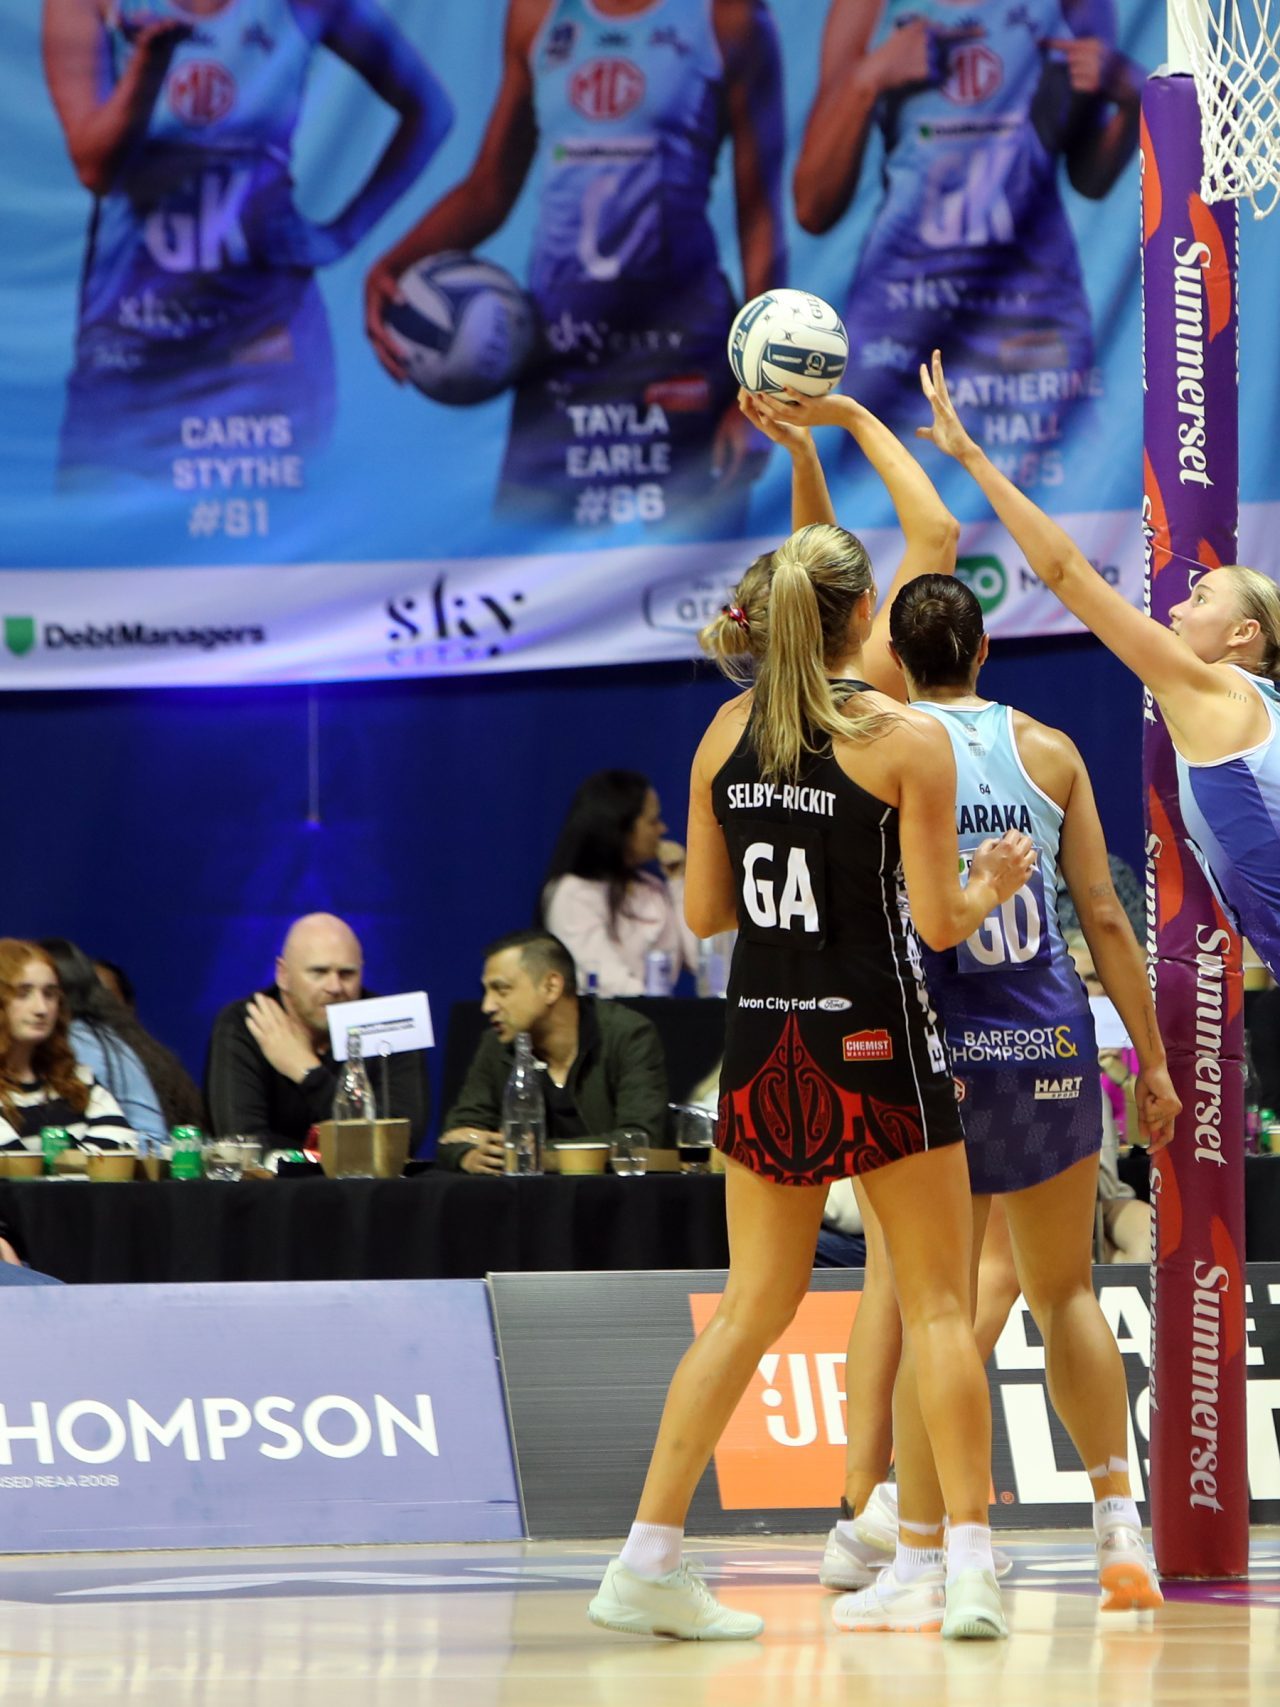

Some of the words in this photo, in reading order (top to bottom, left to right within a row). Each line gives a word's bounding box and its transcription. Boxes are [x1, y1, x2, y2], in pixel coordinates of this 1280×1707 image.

[1173, 236, 1214, 489] Summerset
[180, 414, 293, 448] CARYS
[567, 402, 670, 437] TAYLA
[984, 411, 1062, 445] HALL
[172, 455, 303, 490] STYTHE
[566, 442, 671, 478] EARLE
[44, 622, 267, 650] DebtManagers
[727, 783, 837, 817] SELBY-RICKIT
[979, 783, 991, 795] 64
[955, 804, 1033, 836] ARAKA
[742, 842, 820, 932] GA
[738, 996, 764, 1010] Avon
[766, 997, 790, 1012] City
[792, 997, 816, 1010] Ford
[846, 1040, 889, 1051] CHEMIST
[952, 1043, 1057, 1063] HOMPSON
[964, 1027, 1055, 1047] BARFOOT
[1054, 1025, 1078, 1058] &
[1195, 923, 1231, 1167] Summerset
[1034, 1077, 1083, 1092] HART
[1189, 1260, 1230, 1514] Summerset
[0, 1394, 440, 1465] HOMPSON
[79, 1474, 120, 1487] 2008
